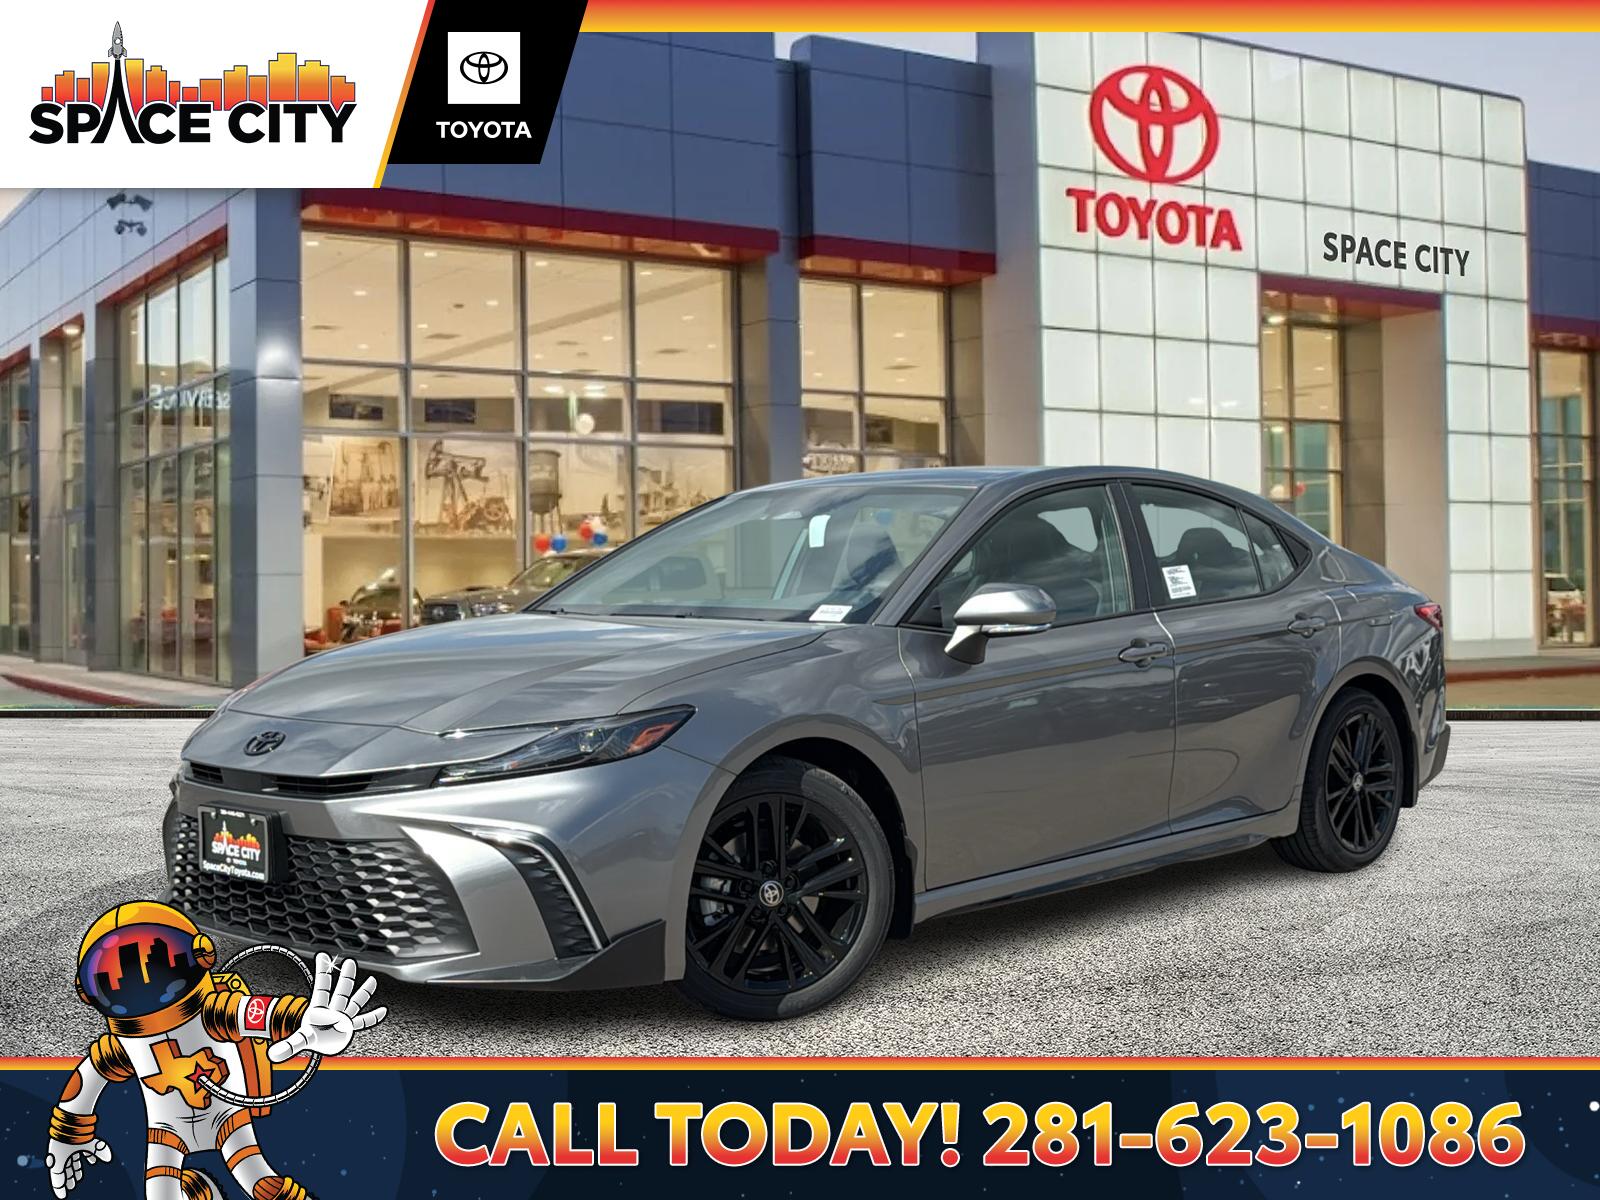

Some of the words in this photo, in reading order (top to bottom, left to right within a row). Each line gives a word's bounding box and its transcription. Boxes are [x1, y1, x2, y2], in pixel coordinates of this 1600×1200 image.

[1066, 187, 1242, 251] TOYOTA
[1323, 232, 1407, 269] SPACE
[1414, 244, 1470, 276] CITY
[212, 841, 240, 857] SPACE
[240, 847, 261, 861] CITY
